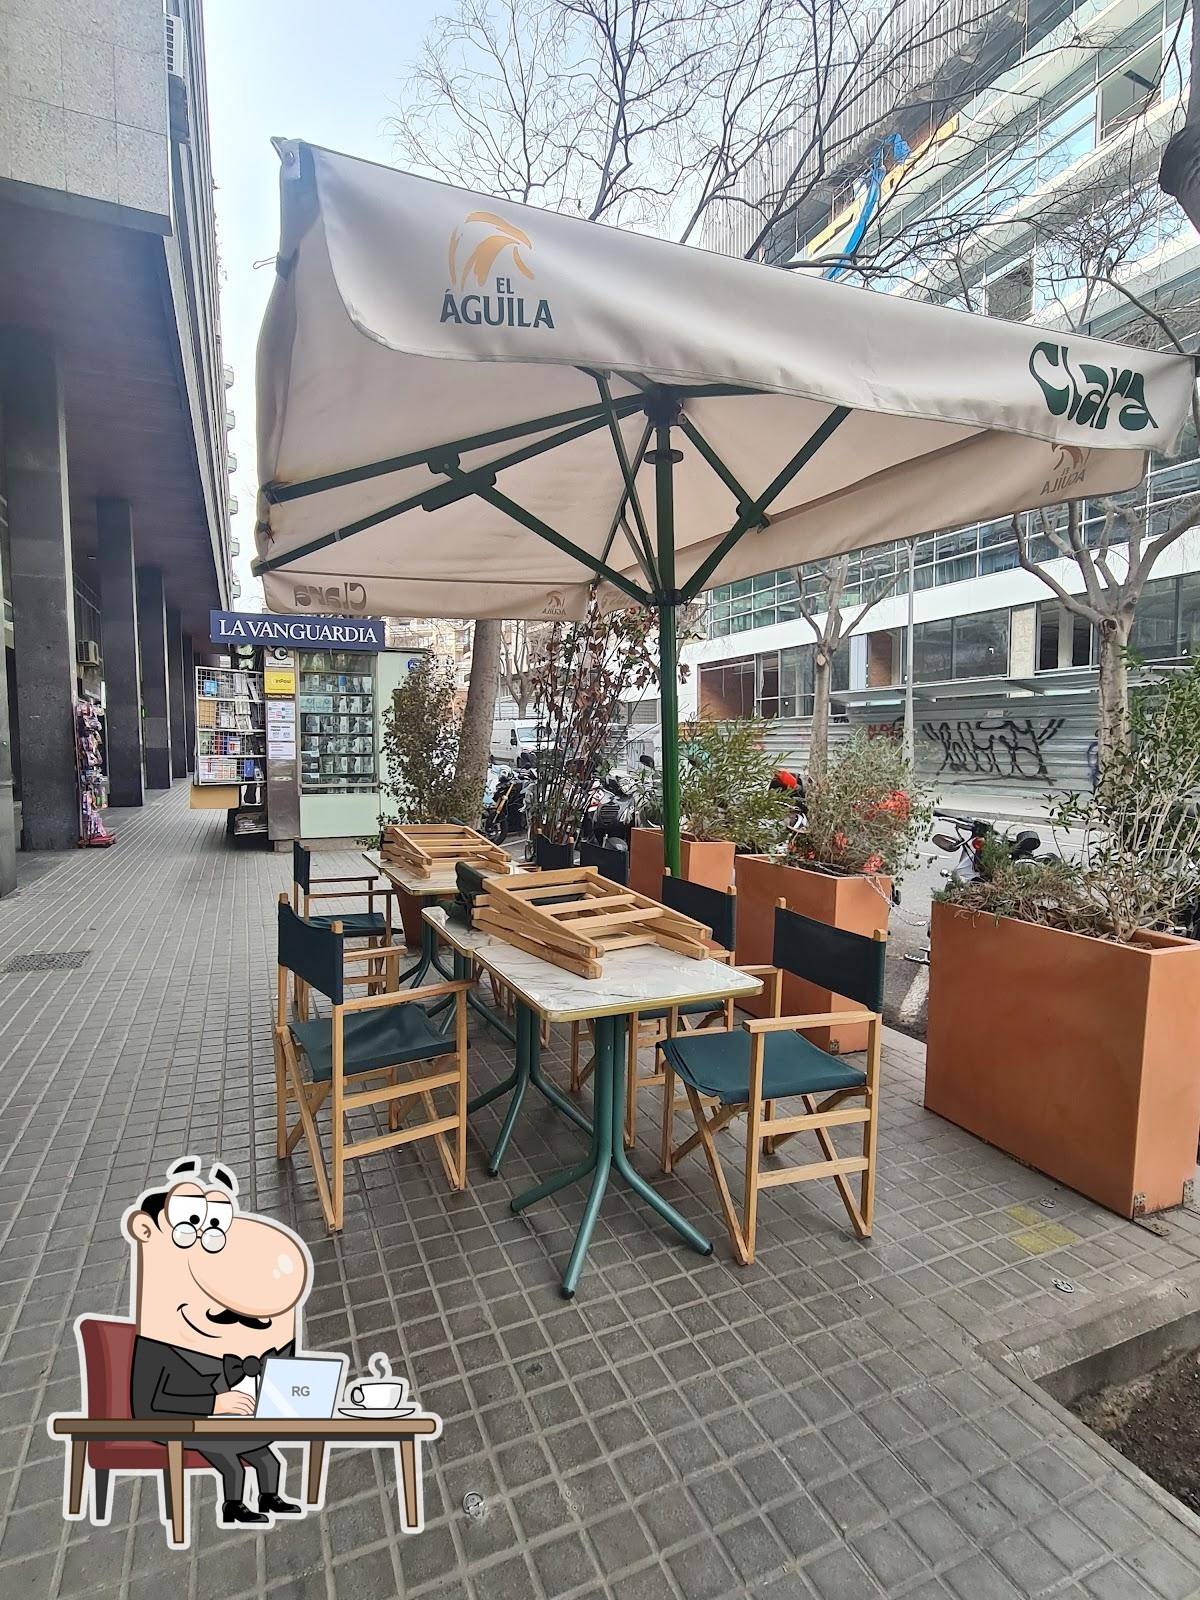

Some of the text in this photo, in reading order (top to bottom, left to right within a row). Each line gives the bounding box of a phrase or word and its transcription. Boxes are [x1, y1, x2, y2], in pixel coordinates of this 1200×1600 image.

[496, 277, 515, 295] EL
[440, 288, 555, 329] ÁGUILA
[1028, 341, 1159, 431] Clara
[219, 619, 378, 643] LA VANGUARDIA
